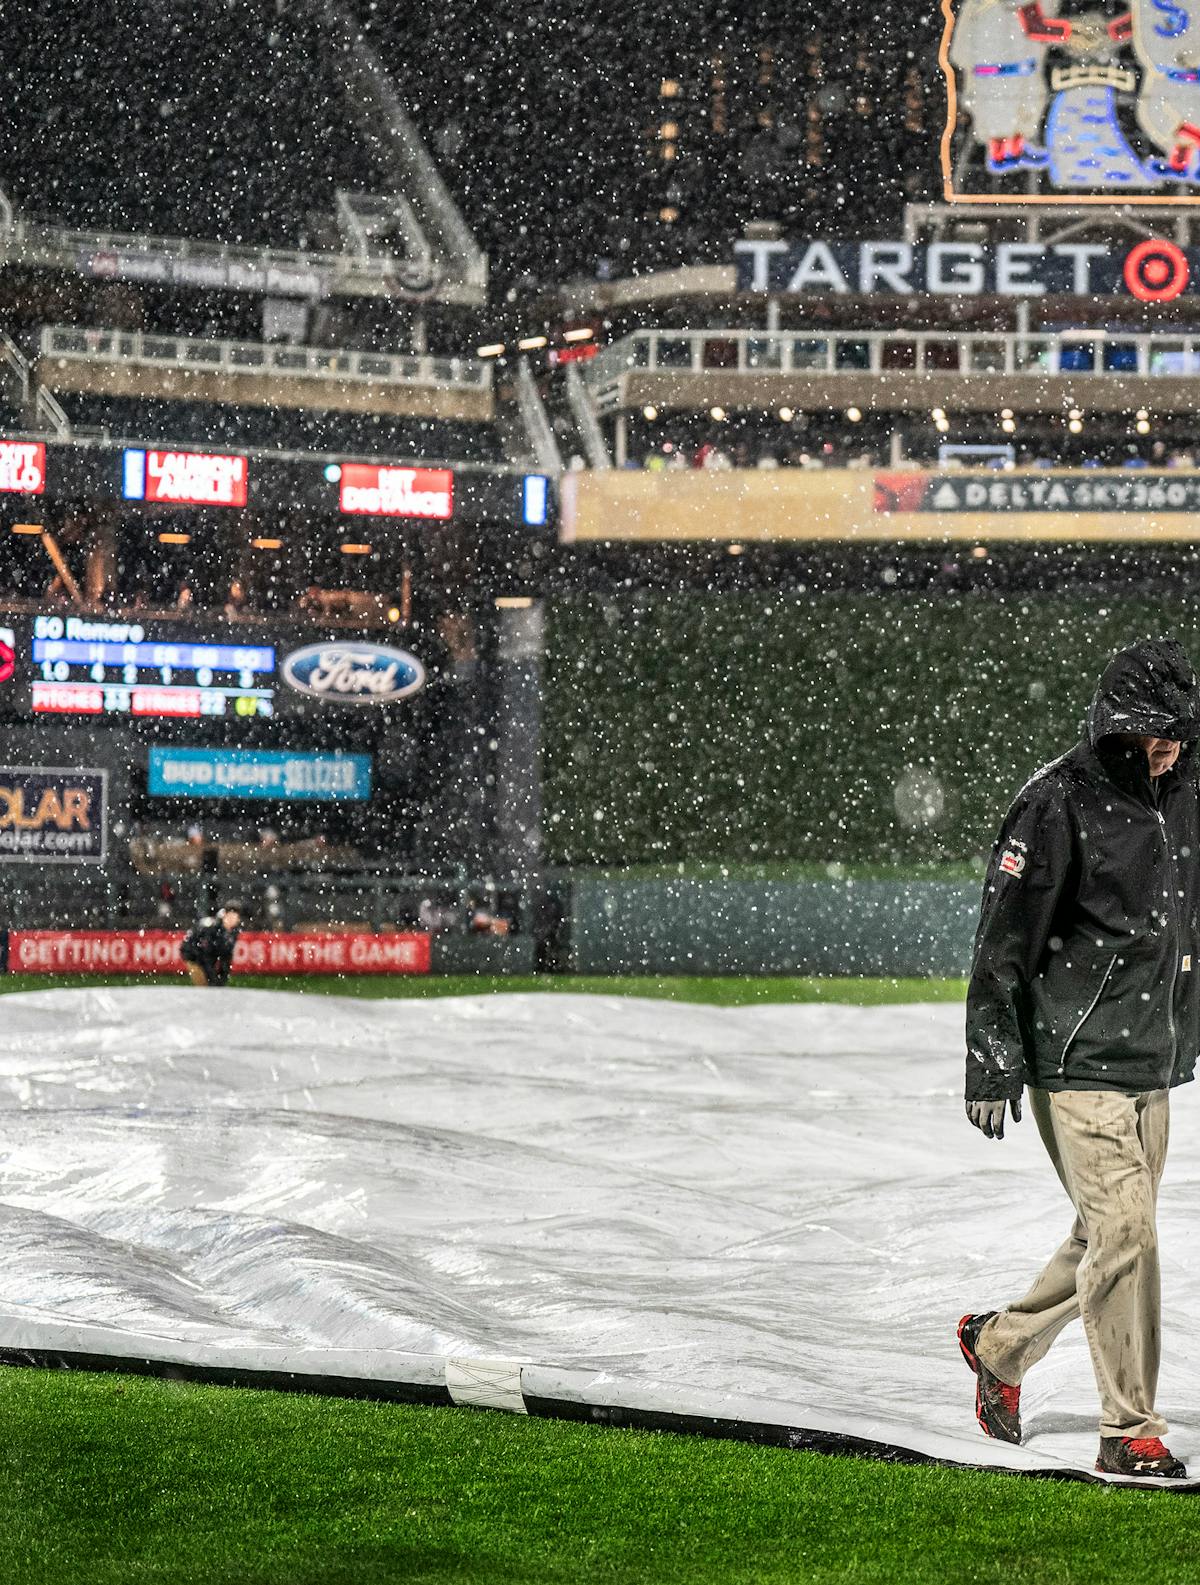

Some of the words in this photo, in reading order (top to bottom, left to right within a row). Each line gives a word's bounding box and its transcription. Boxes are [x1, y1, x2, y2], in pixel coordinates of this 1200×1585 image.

[733, 241, 1107, 296] TARGET
[965, 482, 1070, 506] DELTA
[161, 665, 172, 685] 1
[196, 667, 213, 687] 0
[309, 651, 397, 693] Ford
[163, 760, 212, 784] BUD
[215, 762, 282, 786] LIGHT
[0, 830, 93, 851] olar.com
[19, 938, 128, 966] GETTING
[271, 939, 297, 966] IN
[303, 939, 345, 966] THE
[351, 939, 417, 966] GAME
